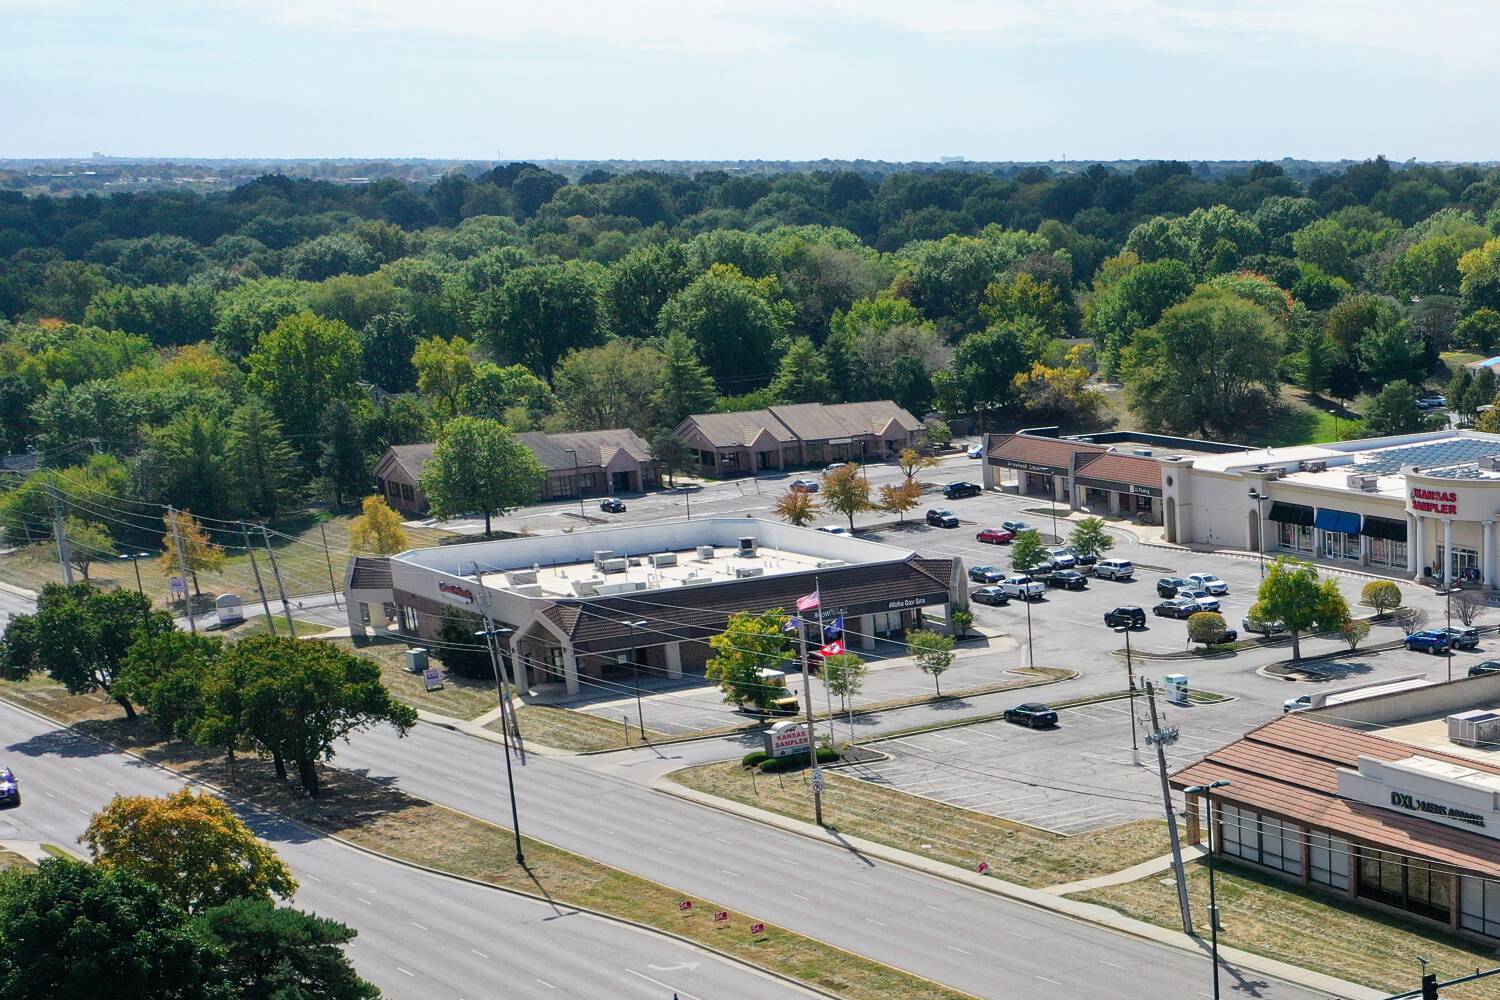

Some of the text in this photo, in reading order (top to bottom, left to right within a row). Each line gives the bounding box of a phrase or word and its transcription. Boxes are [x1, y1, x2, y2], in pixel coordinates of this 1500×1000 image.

[1413, 488, 1457, 503] KANSAS
[1412, 500, 1457, 515] SAMPLER
[775, 737, 809, 748] SAMPLER
[776, 731, 806, 741] KANSAS
[1391, 791, 1416, 811] DXL
